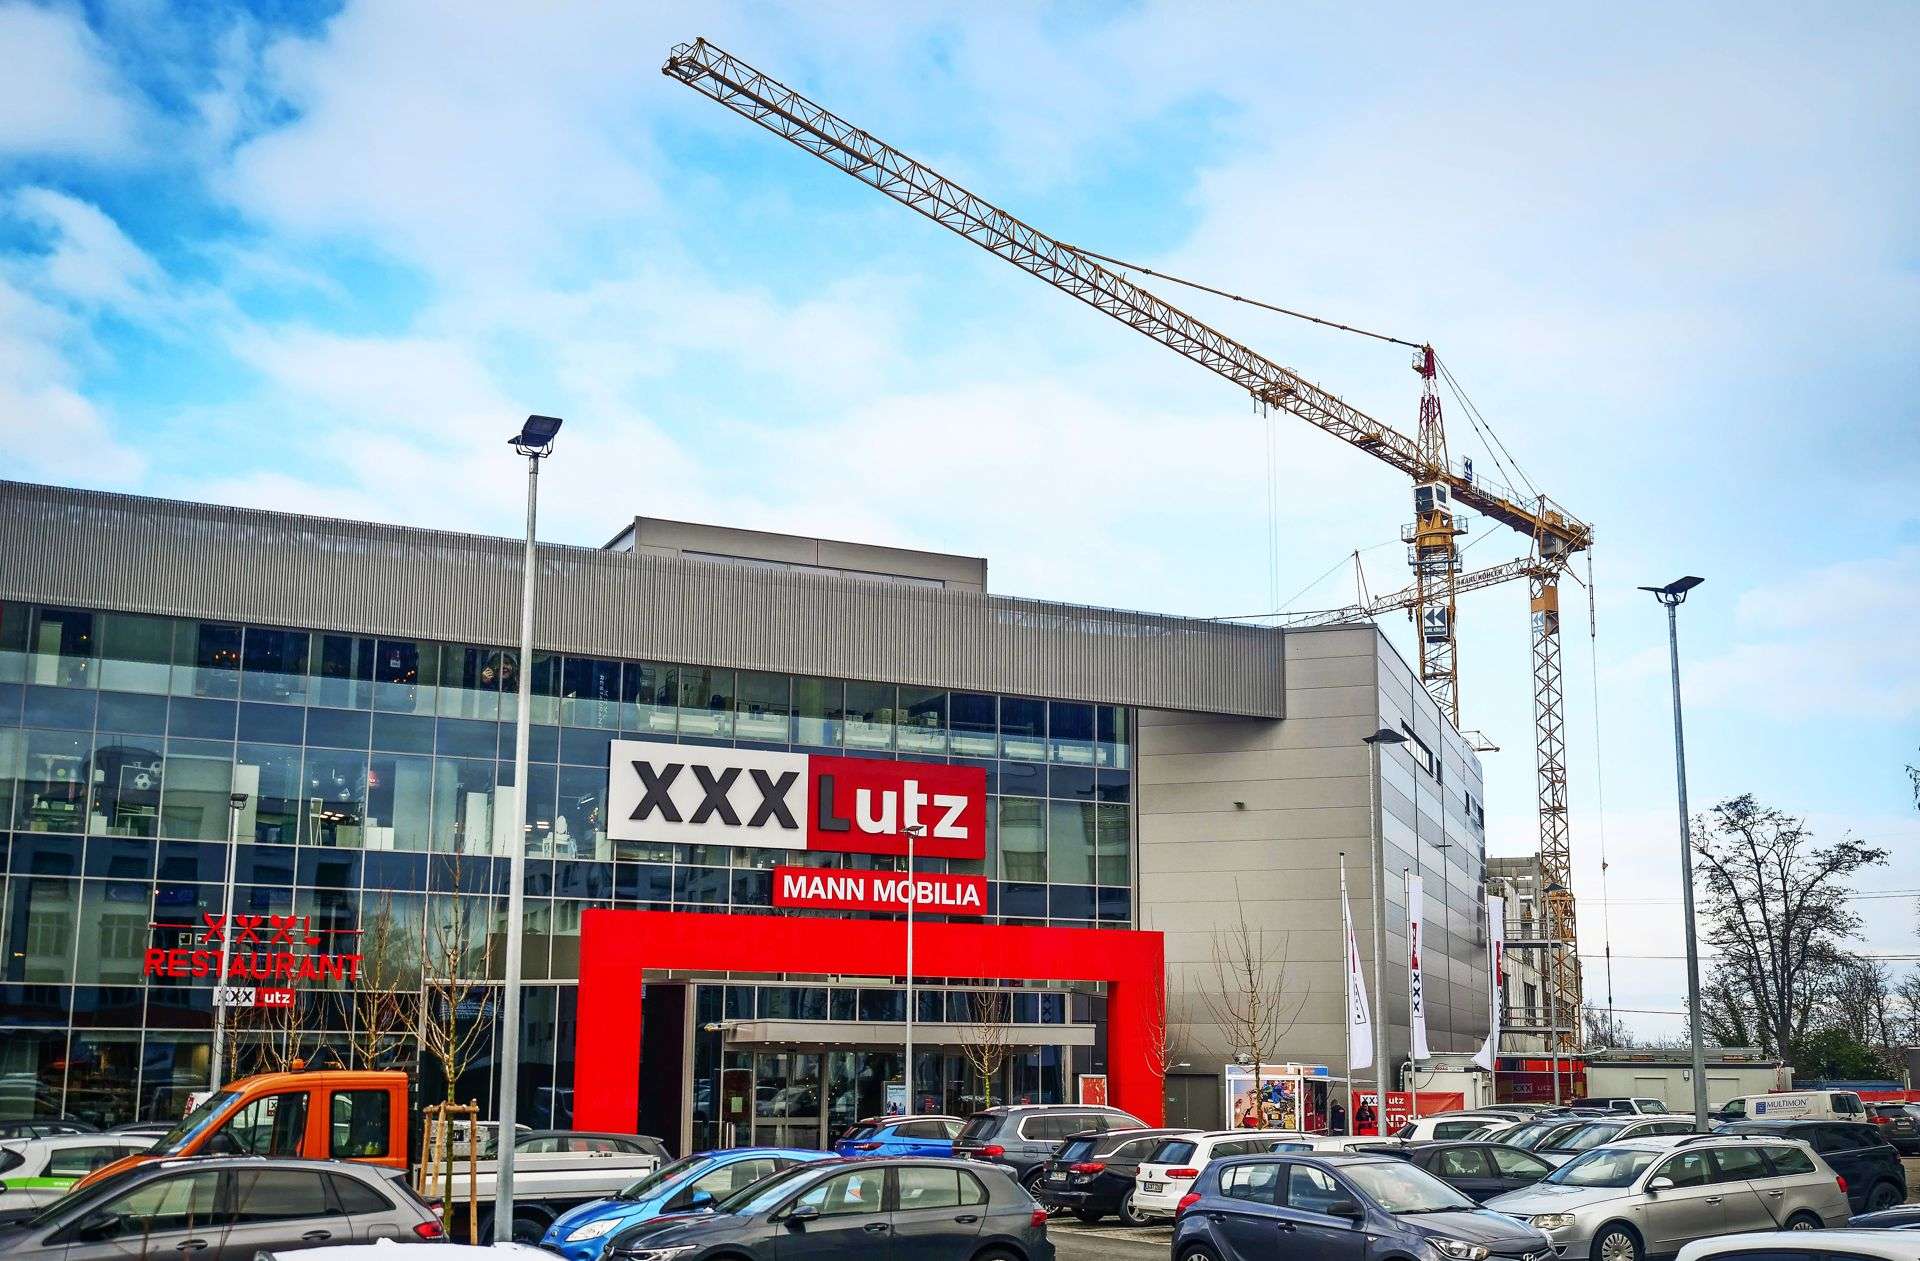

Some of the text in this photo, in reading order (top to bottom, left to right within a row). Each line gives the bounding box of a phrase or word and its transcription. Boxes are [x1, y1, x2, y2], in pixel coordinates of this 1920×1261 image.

[783, 874, 981, 907] MANN MOBILIA
[144, 948, 363, 981] RESTAURANT
